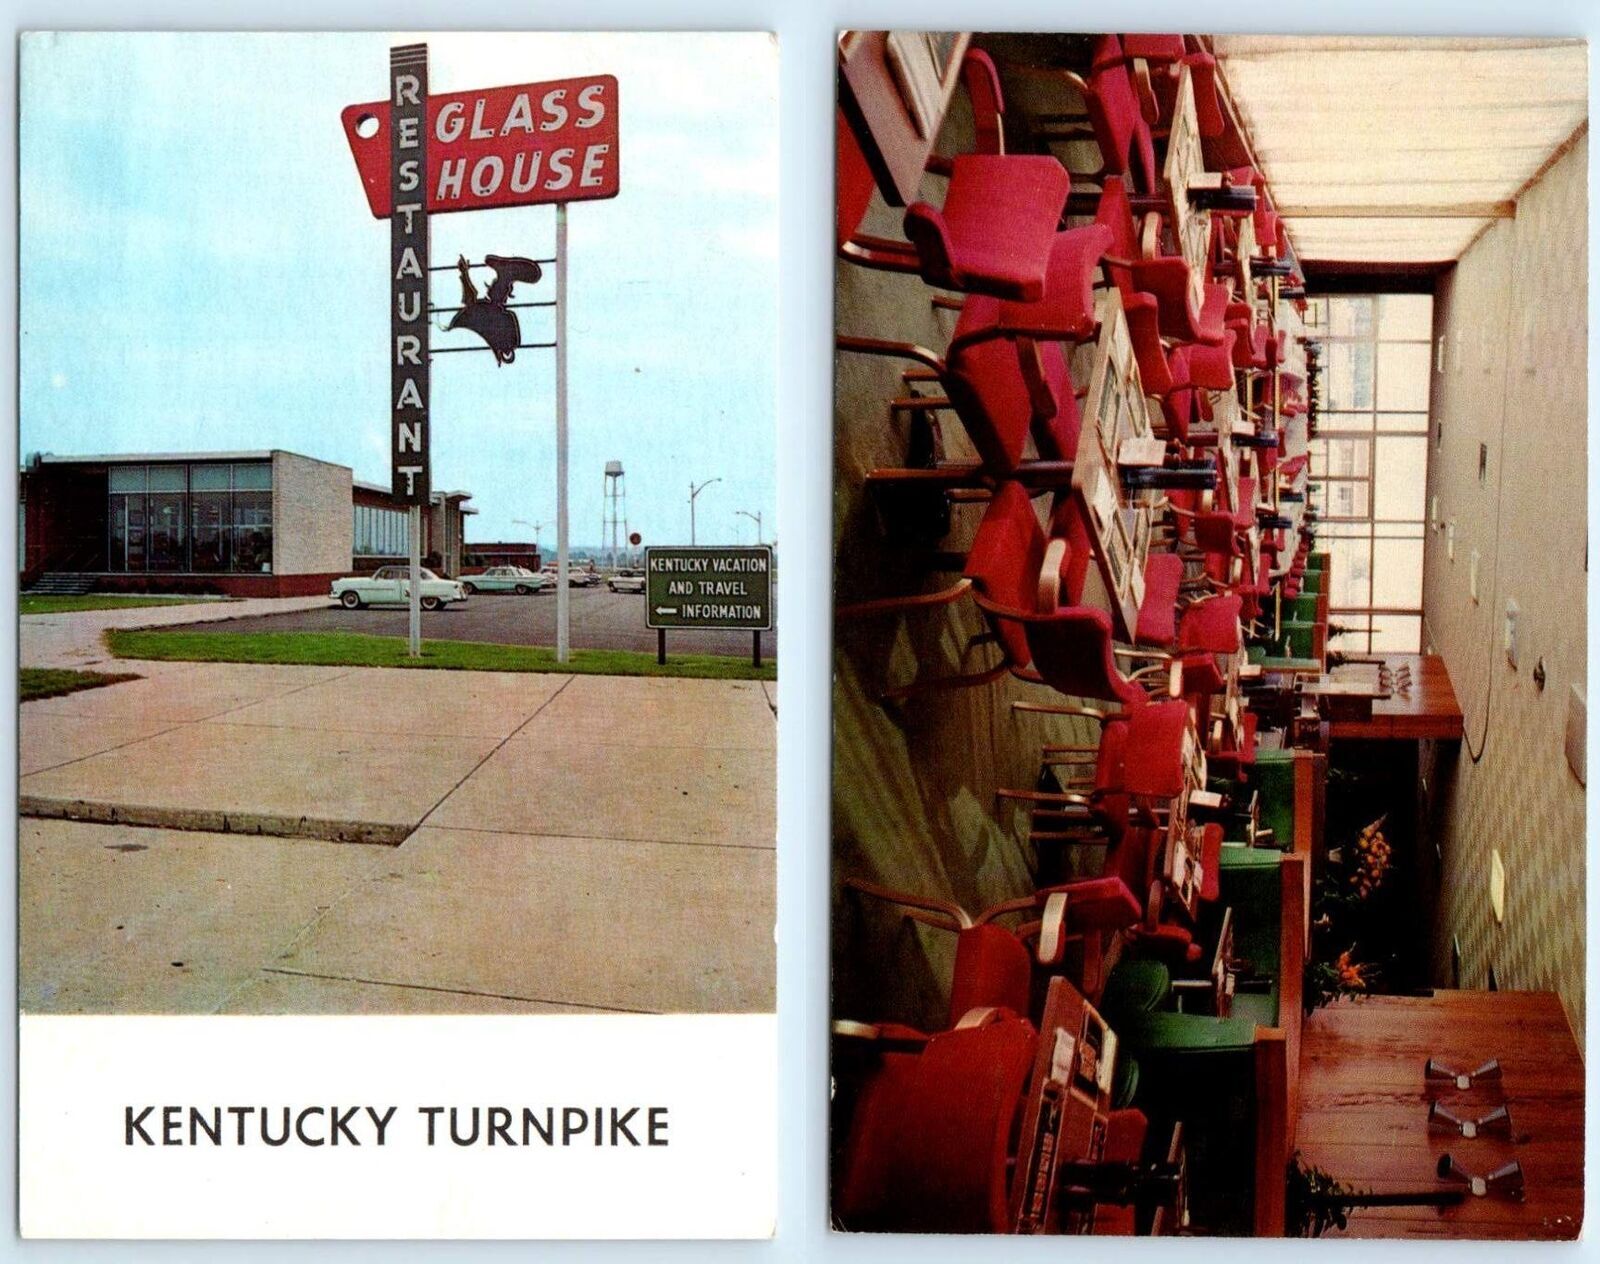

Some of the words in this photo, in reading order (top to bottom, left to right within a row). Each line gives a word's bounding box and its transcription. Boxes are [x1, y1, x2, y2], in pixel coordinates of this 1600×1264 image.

[435, 84, 605, 143] GLASS
[436, 144, 609, 200] HOUSE
[395, 74, 424, 497] RESTAURANT
[650, 557, 709, 572] KENTUCKY
[712, 558, 767, 572] VACATION
[668, 581, 694, 595] AND
[698, 581, 748, 596] TRAVEL
[682, 604, 761, 619] INFORMATION
[124, 1106, 398, 1146] KENTUCKY
[418, 1106, 669, 1146] TURNPIKE
